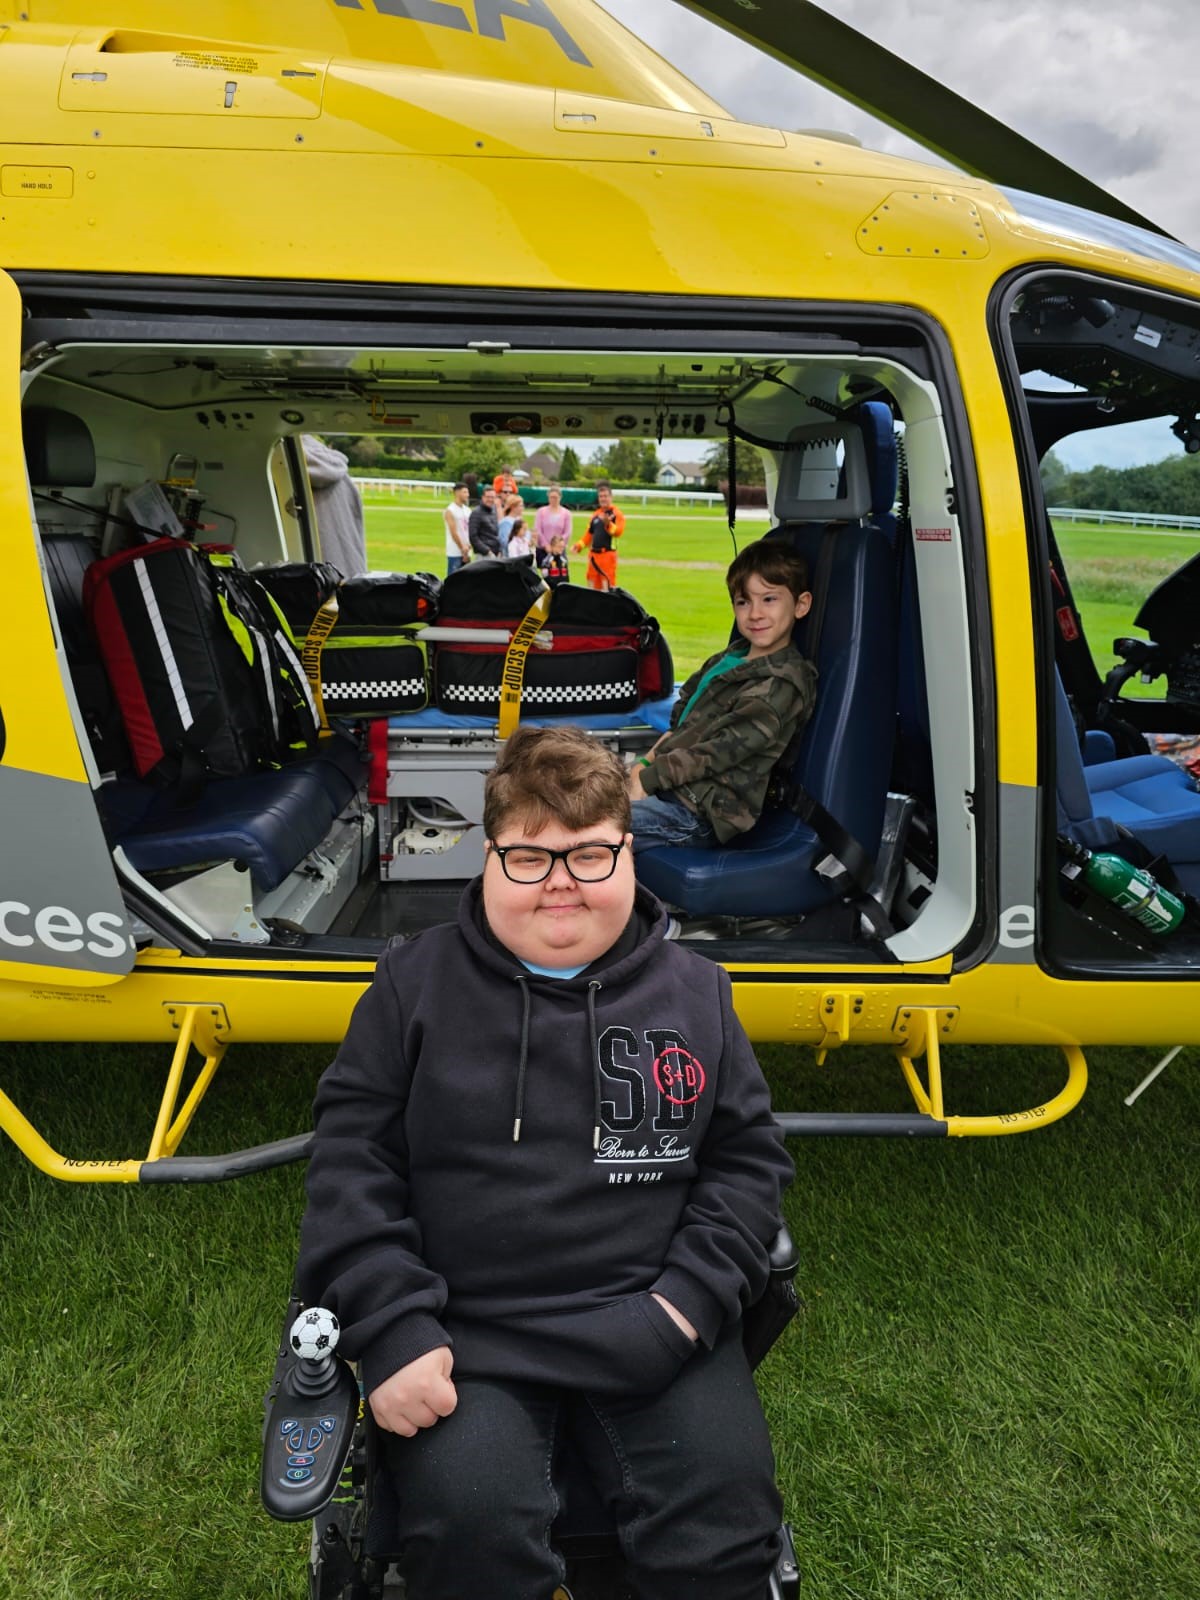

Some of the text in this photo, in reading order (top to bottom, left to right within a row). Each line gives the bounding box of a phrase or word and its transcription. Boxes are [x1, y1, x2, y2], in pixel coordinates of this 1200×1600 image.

[513, 616, 543, 647] WMAS
[303, 639, 322, 680] SCOOP
[504, 649, 526, 691] SCOOP
[0, 900, 127, 958] ces
[998, 1107, 1046, 1124] NO STEP
[597, 1135, 636, 1158] Born
[637, 1144, 650, 1158] to
[63, 1159, 87, 1167] NO
[608, 1171, 664, 1184] NEW YORK
